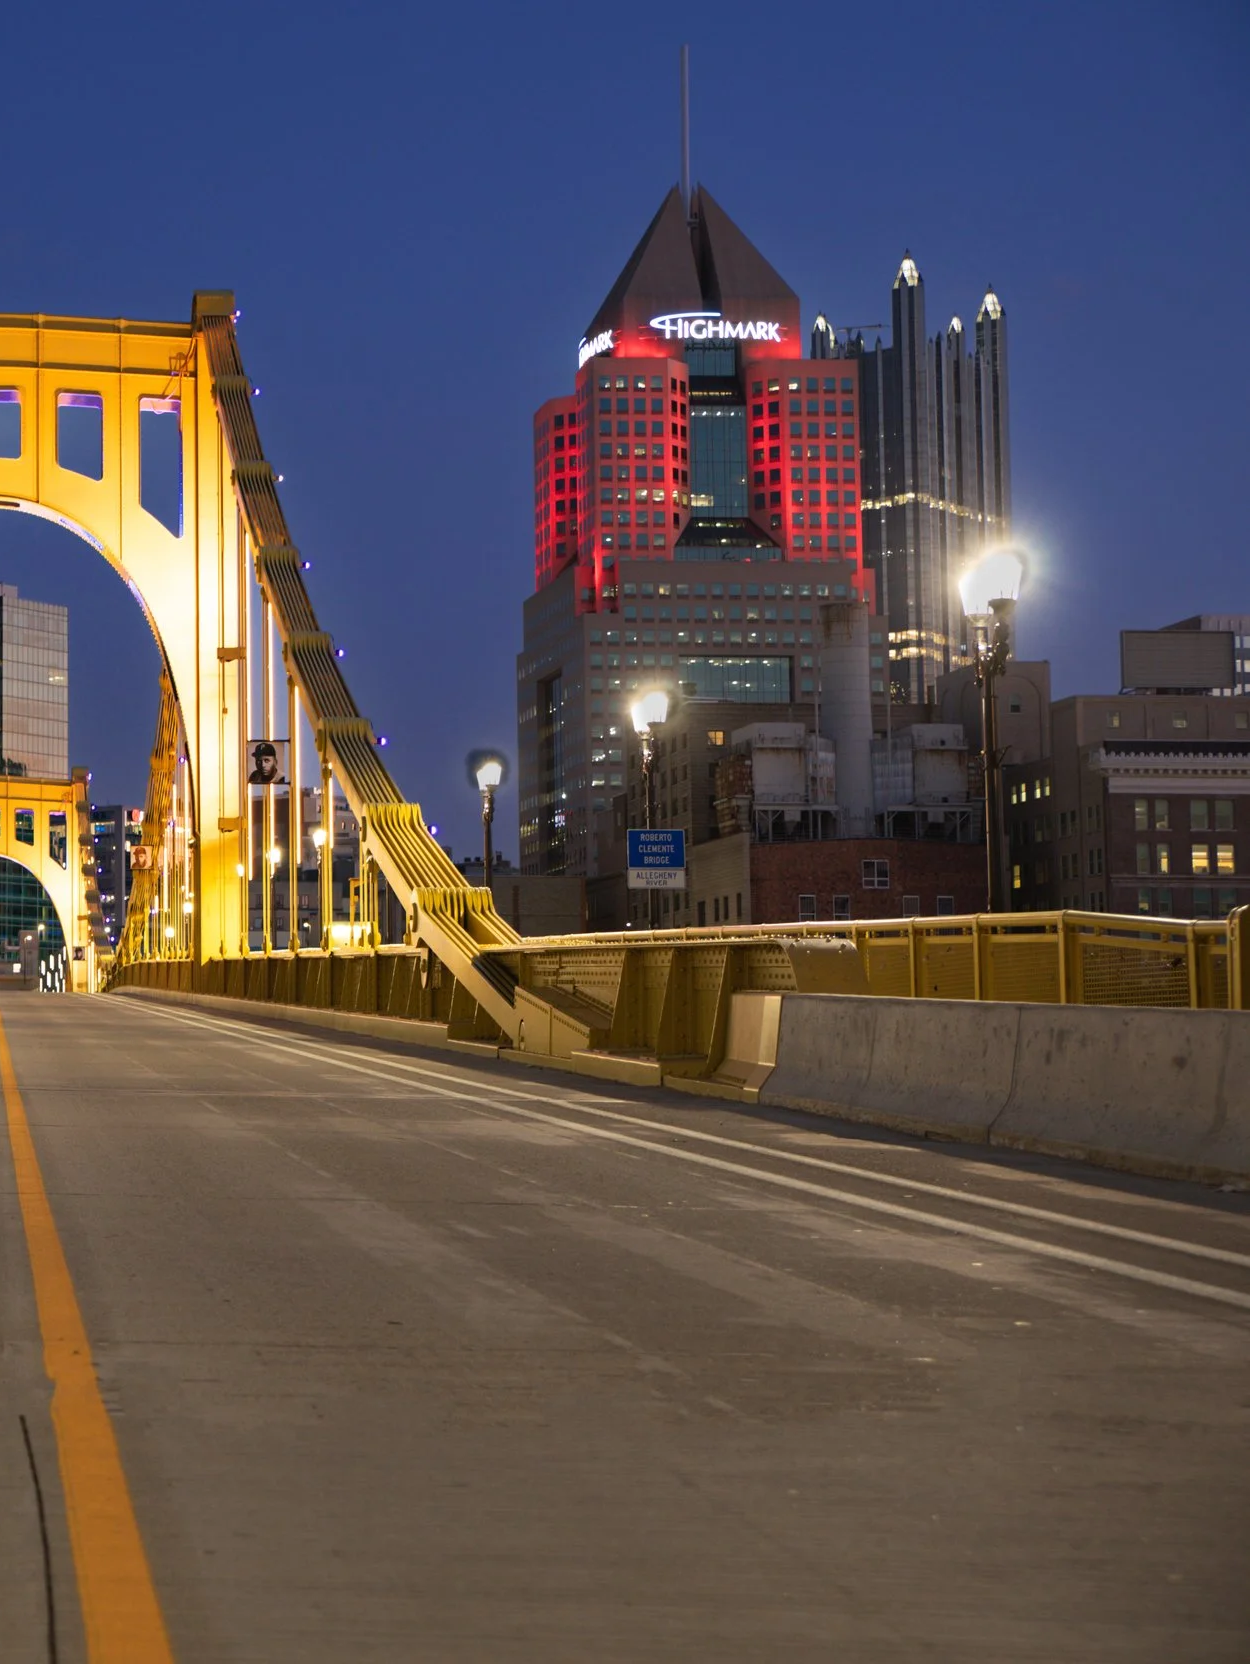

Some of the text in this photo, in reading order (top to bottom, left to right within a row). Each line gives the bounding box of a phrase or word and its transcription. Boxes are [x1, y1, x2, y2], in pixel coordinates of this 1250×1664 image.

[650, 312, 781, 342] HIGHMARK
[640, 833, 672, 842] ROBERTO
[638, 844, 675, 853] CLEMENTE
[643, 856, 670, 864] BRIDGE
[636, 871, 678, 880] ALLEGHENY
